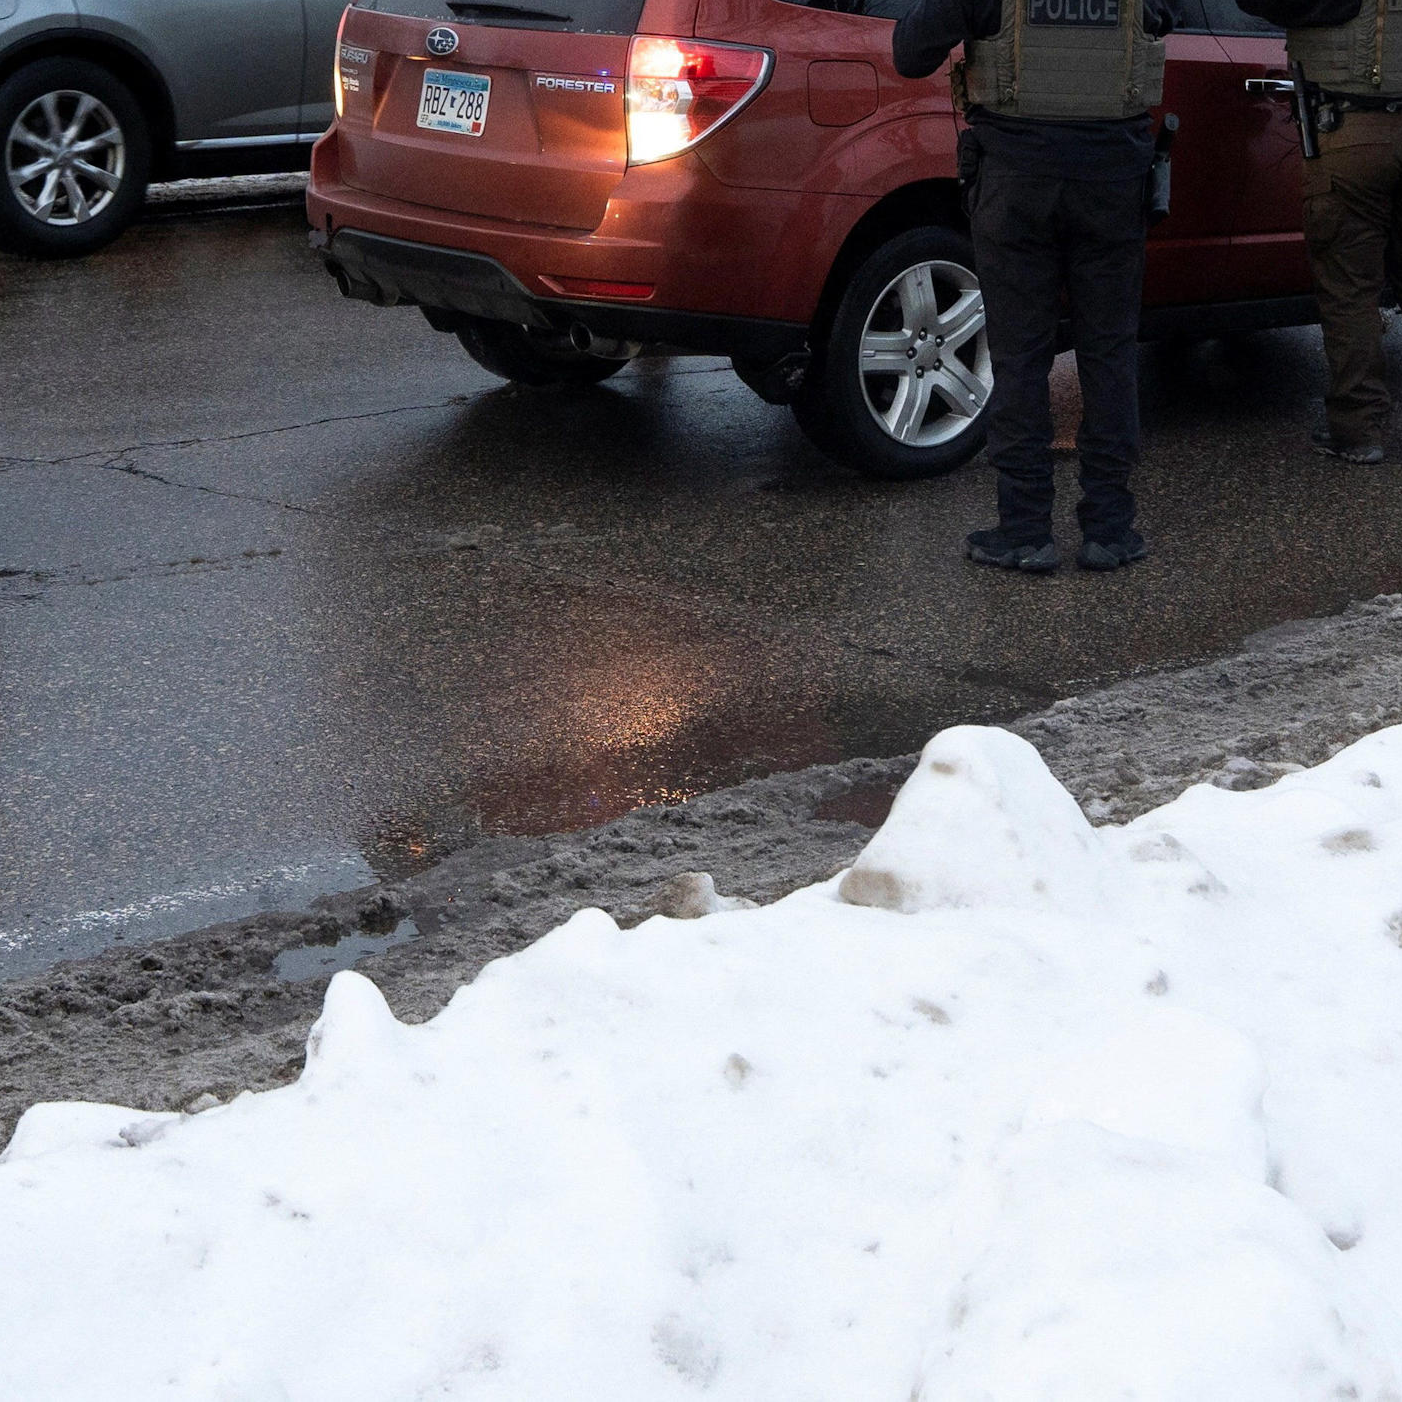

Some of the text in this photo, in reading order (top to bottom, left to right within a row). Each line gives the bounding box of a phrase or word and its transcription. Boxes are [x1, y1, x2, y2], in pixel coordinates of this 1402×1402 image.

[535, 77, 616, 94] FORESTER
[422, 85, 484, 121] RBZ 288
